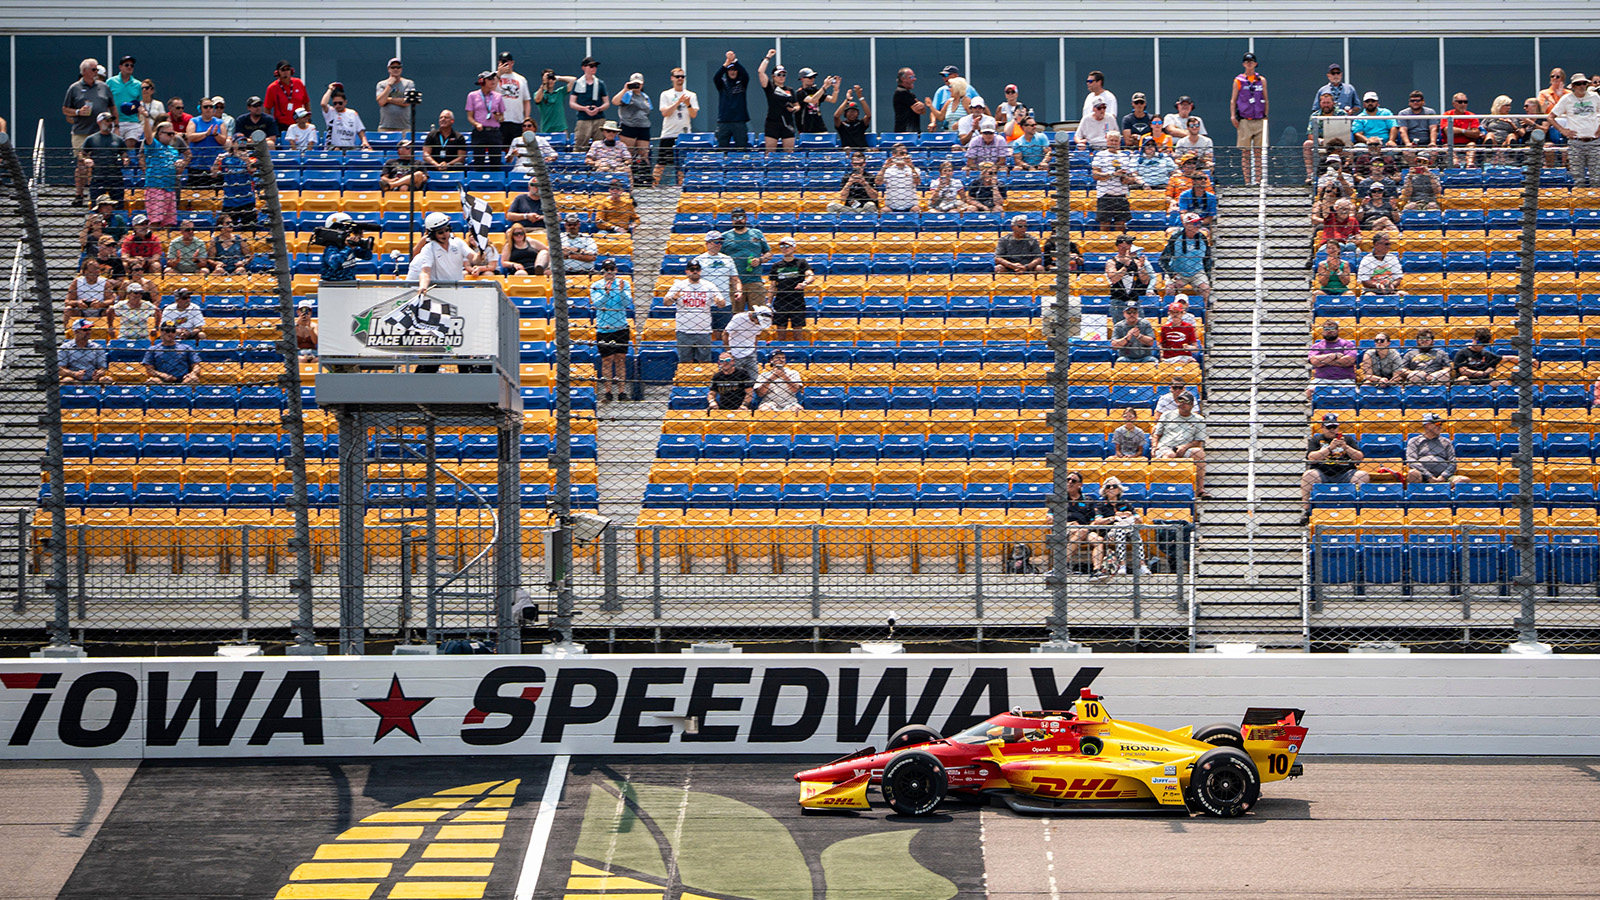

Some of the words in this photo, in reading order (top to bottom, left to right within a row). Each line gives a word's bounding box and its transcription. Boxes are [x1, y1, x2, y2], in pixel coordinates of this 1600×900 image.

[369, 318, 464, 336] INDR
[367, 335, 401, 346] RACE
[402, 335, 463, 346] WEEKEND
[0, 669, 325, 748] IOWA
[461, 665, 1104, 745] SPEEDWAY
[1084, 702, 1099, 718] 10
[1119, 744, 1170, 752] HONDA
[1267, 753, 1289, 775] 10
[1031, 776, 1122, 798] DHL
